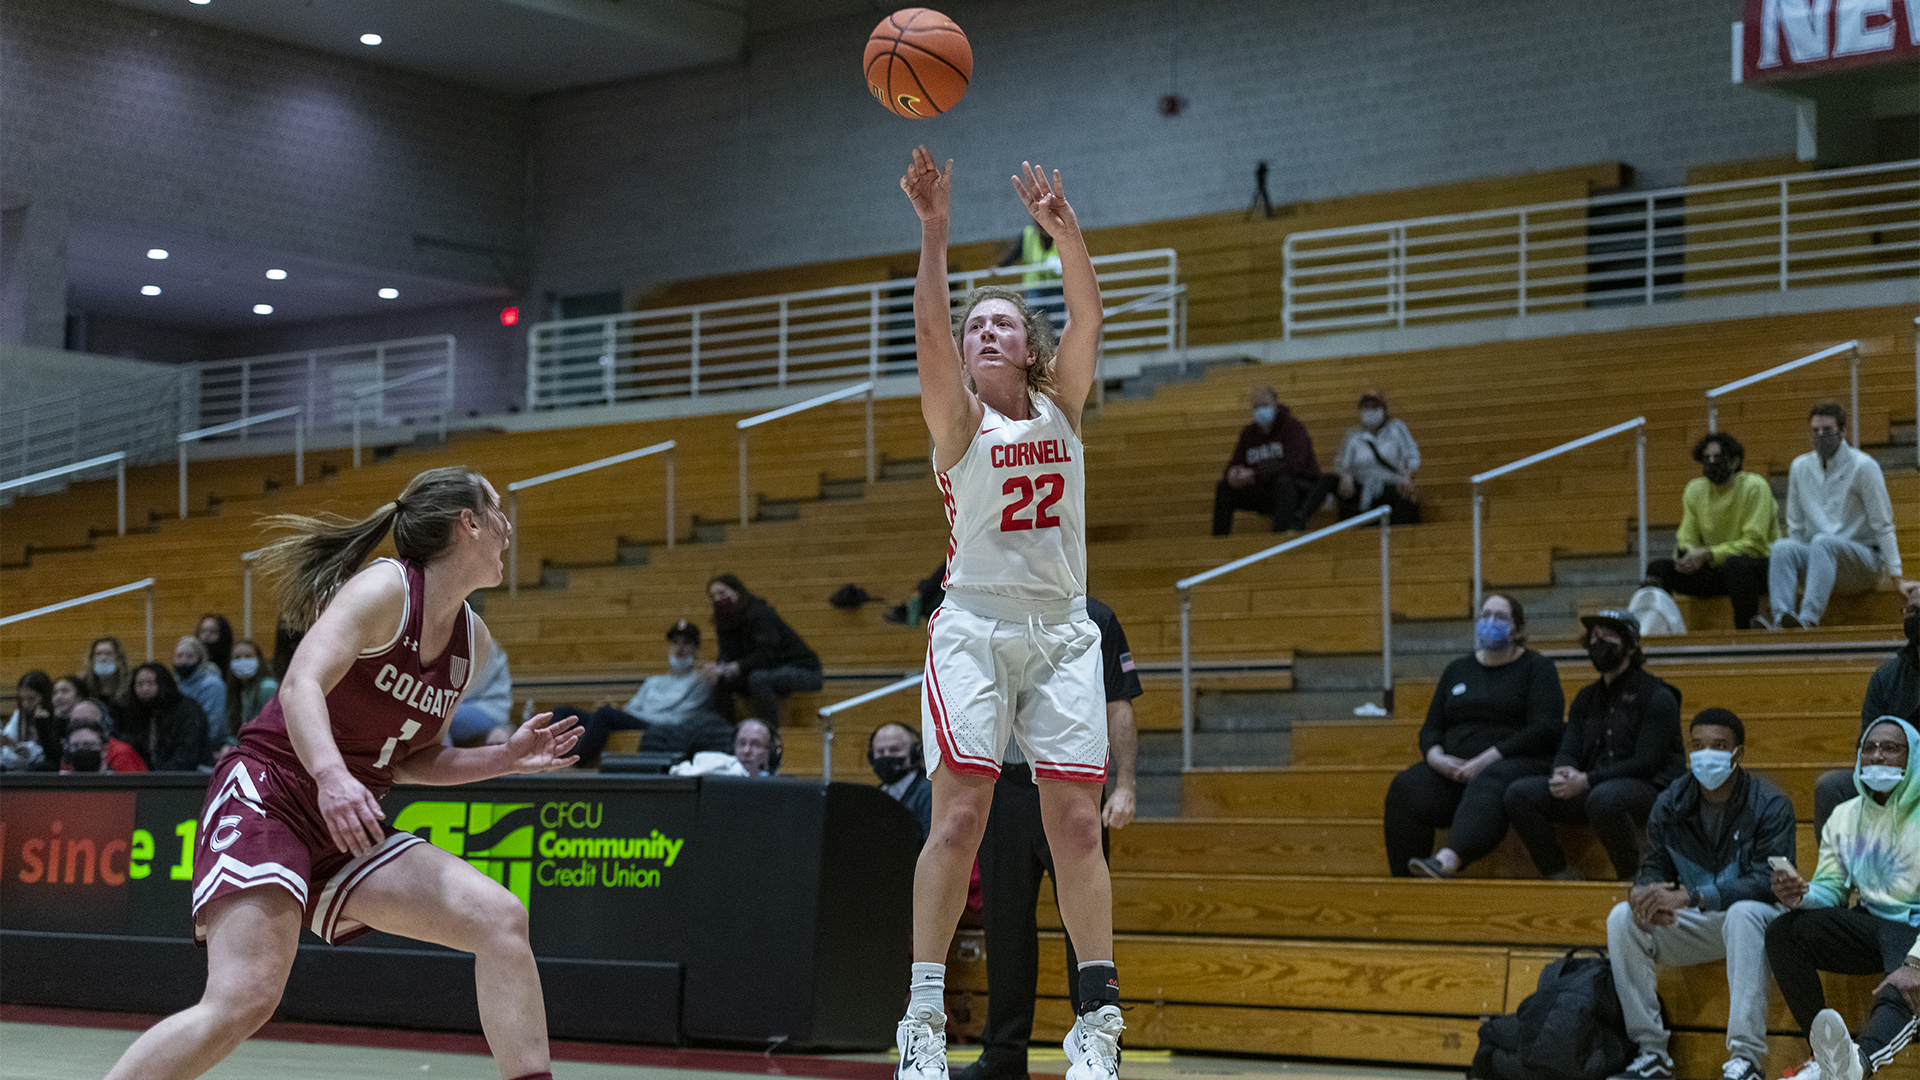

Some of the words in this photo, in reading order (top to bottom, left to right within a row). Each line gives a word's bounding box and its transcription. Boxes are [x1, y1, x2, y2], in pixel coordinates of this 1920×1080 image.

[1756, 0, 1920, 69] NE
[990, 438, 1072, 469] CORNELL
[1000, 472, 1065, 532] 22
[372, 718, 422, 769] 1
[539, 801, 603, 829] CFCU
[19, 819, 155, 886] since
[538, 828, 685, 868] Community
[536, 858, 597, 887] Credit
[601, 860, 661, 888] Union
